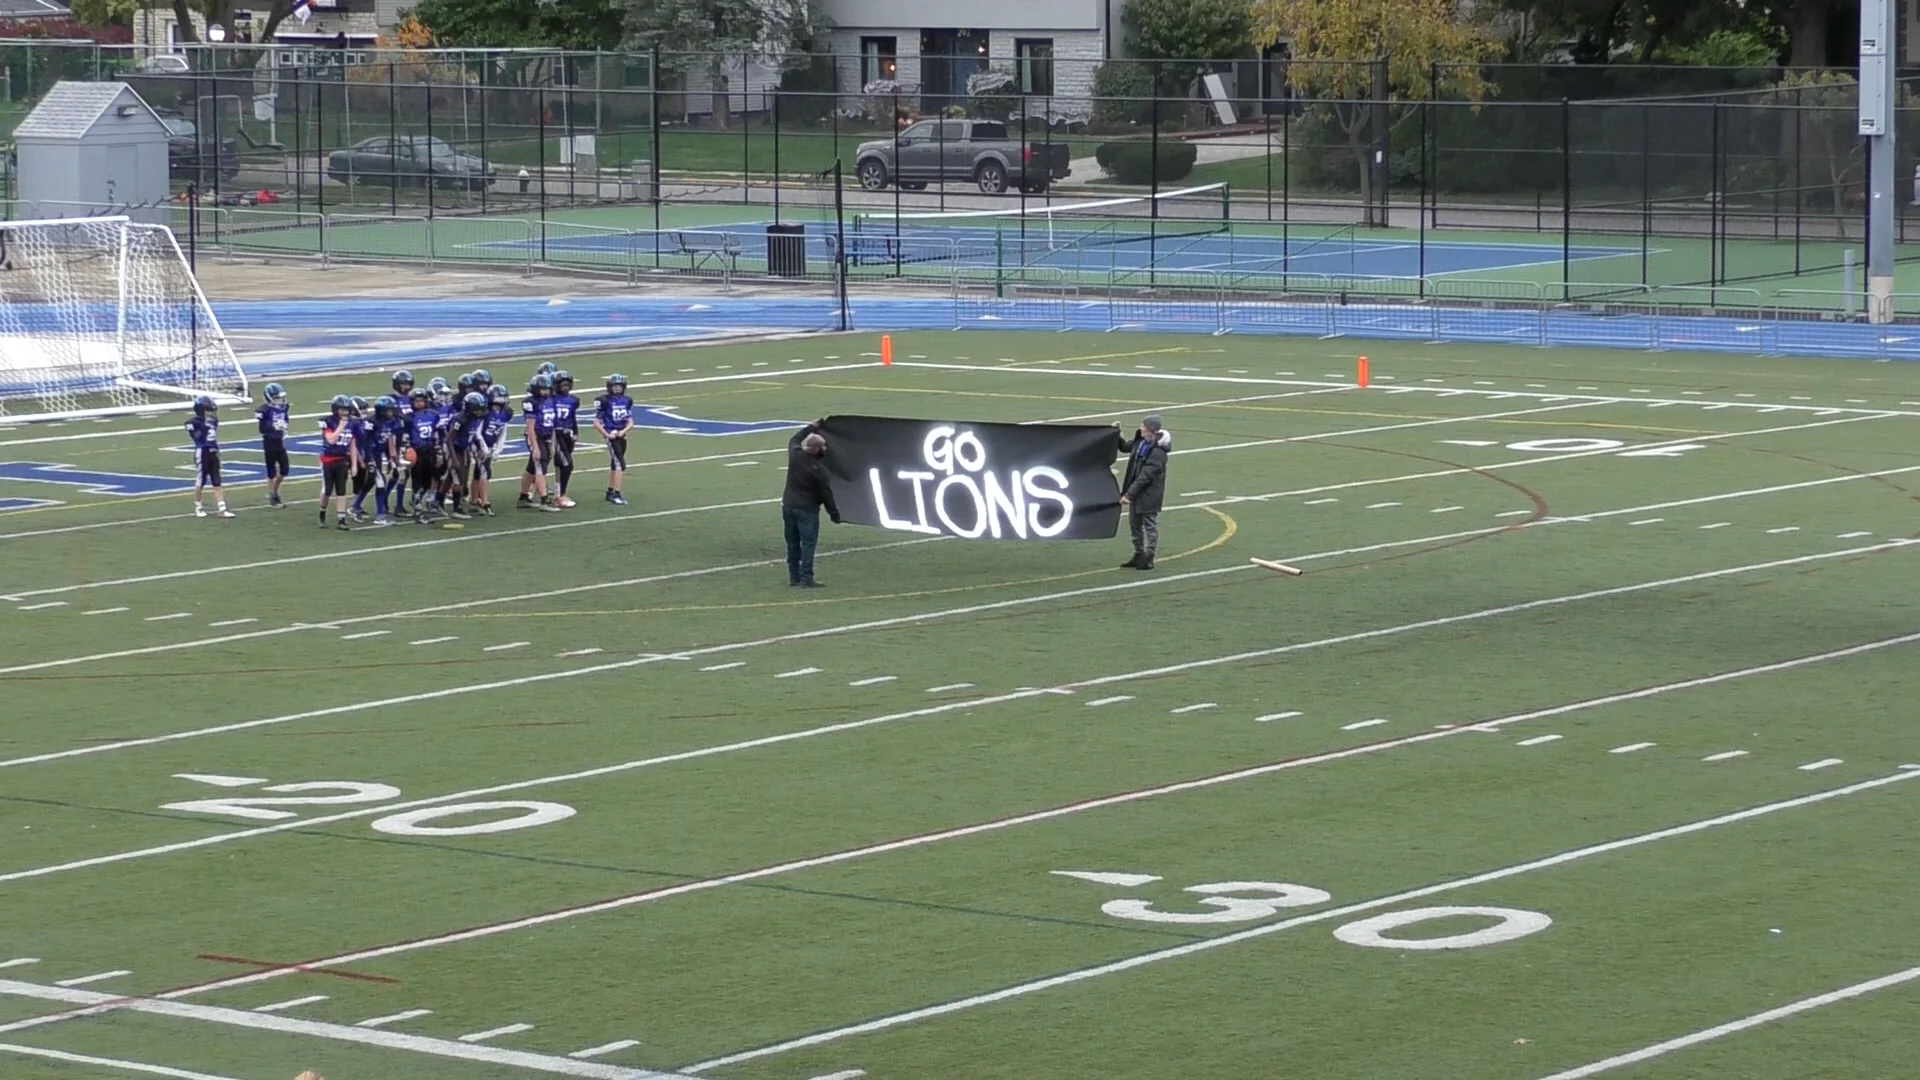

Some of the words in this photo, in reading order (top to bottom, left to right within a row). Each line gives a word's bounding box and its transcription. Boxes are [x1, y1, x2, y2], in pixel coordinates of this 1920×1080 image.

[556, 408, 570, 419] 17
[419, 426, 432, 439] 21
[923, 426, 986, 475] GO
[869, 465, 1074, 539] LIONS
